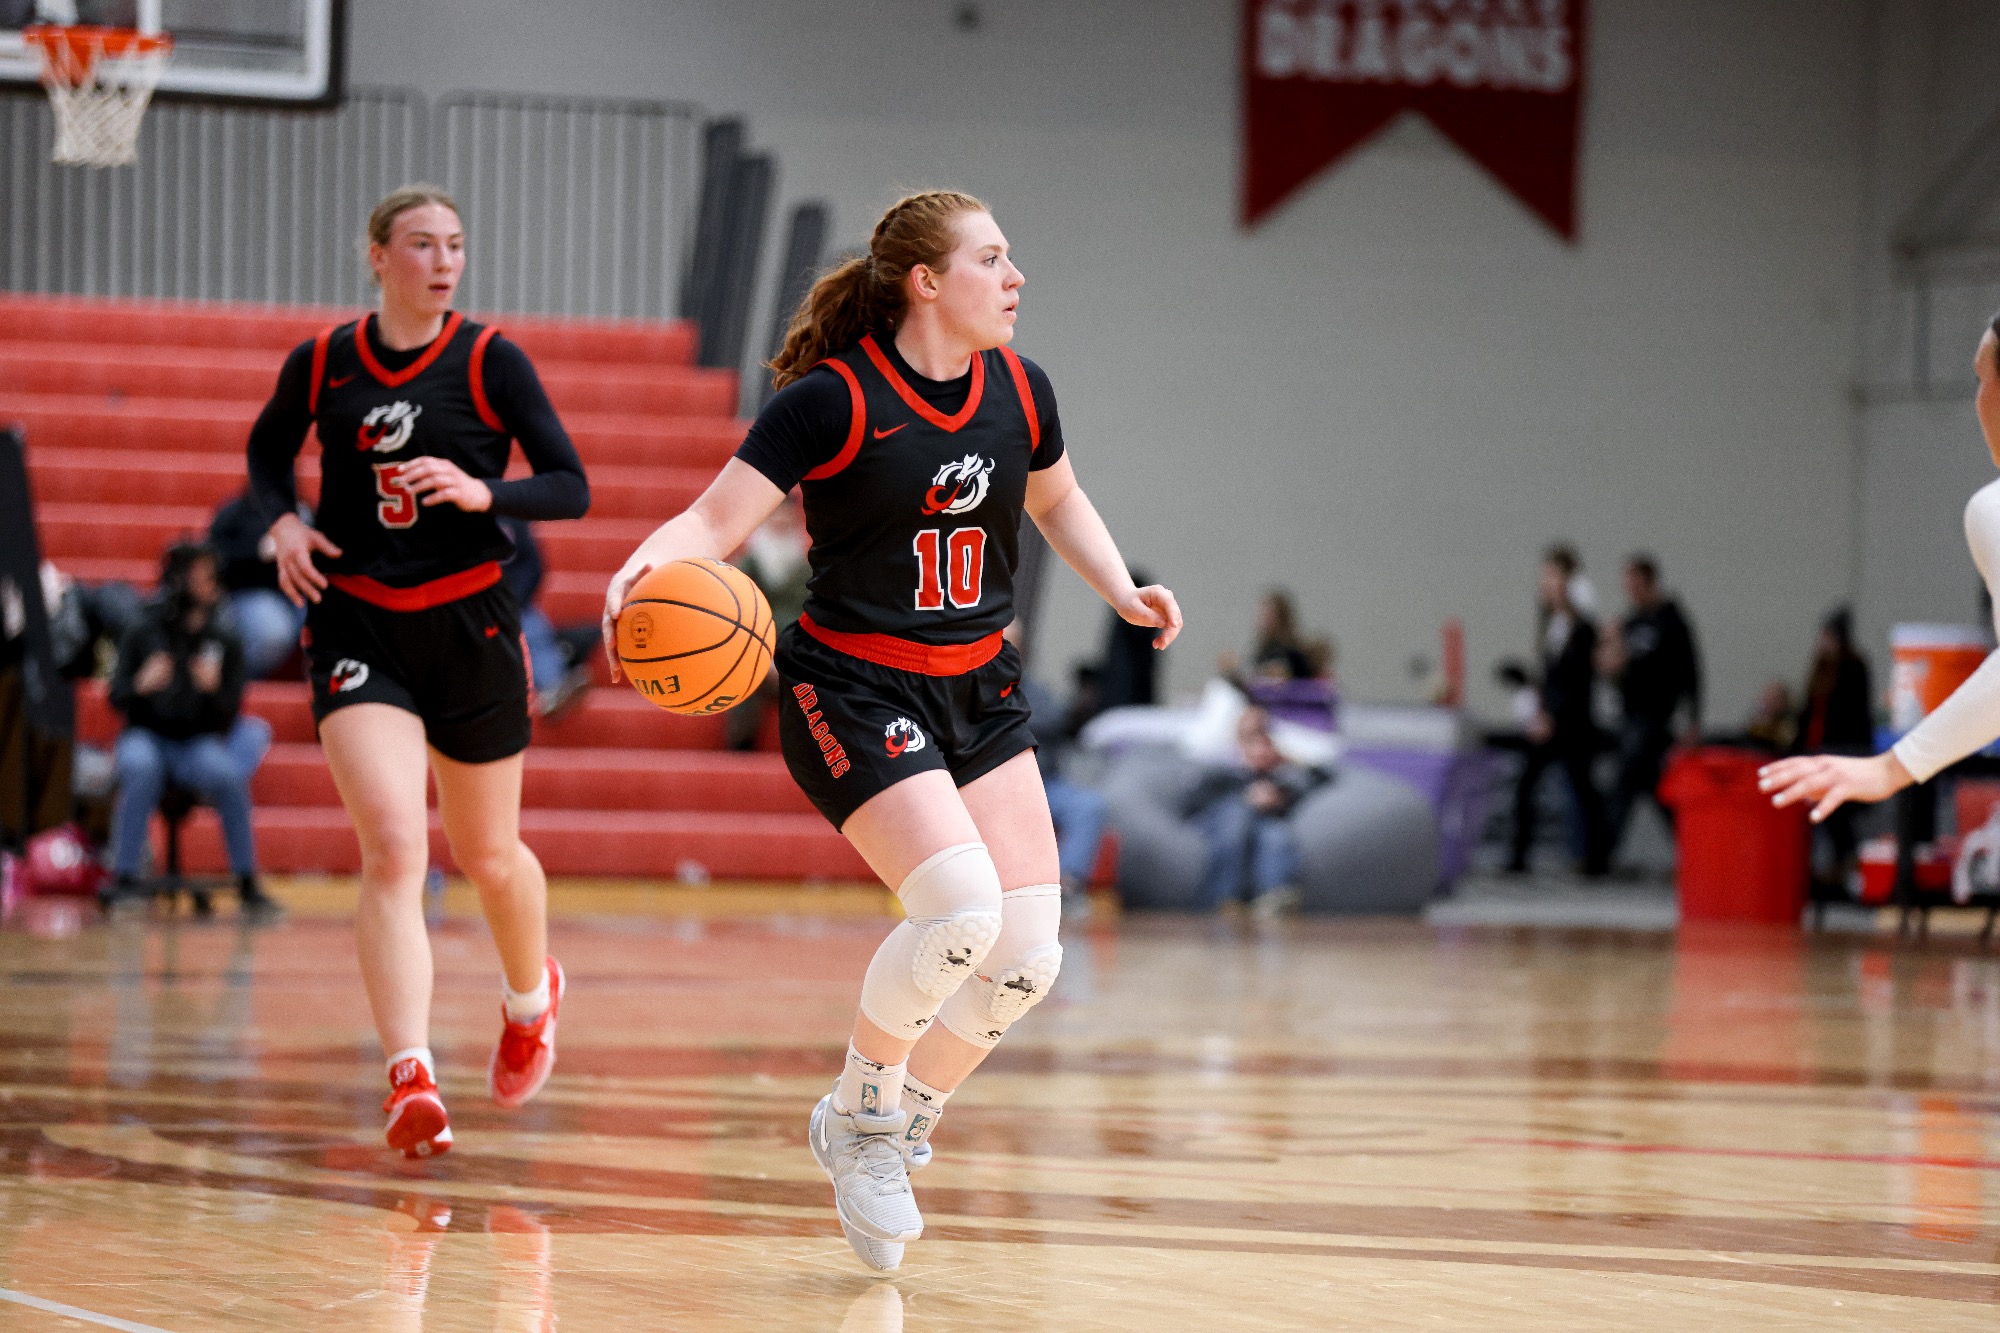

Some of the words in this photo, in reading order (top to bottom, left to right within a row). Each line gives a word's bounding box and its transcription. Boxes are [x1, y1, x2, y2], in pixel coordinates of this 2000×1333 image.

[1257, 11, 1571, 92] DRAGONS
[372, 461, 418, 529] 5
[913, 526, 987, 611] 10
[792, 682, 851, 779] DRAGONS
